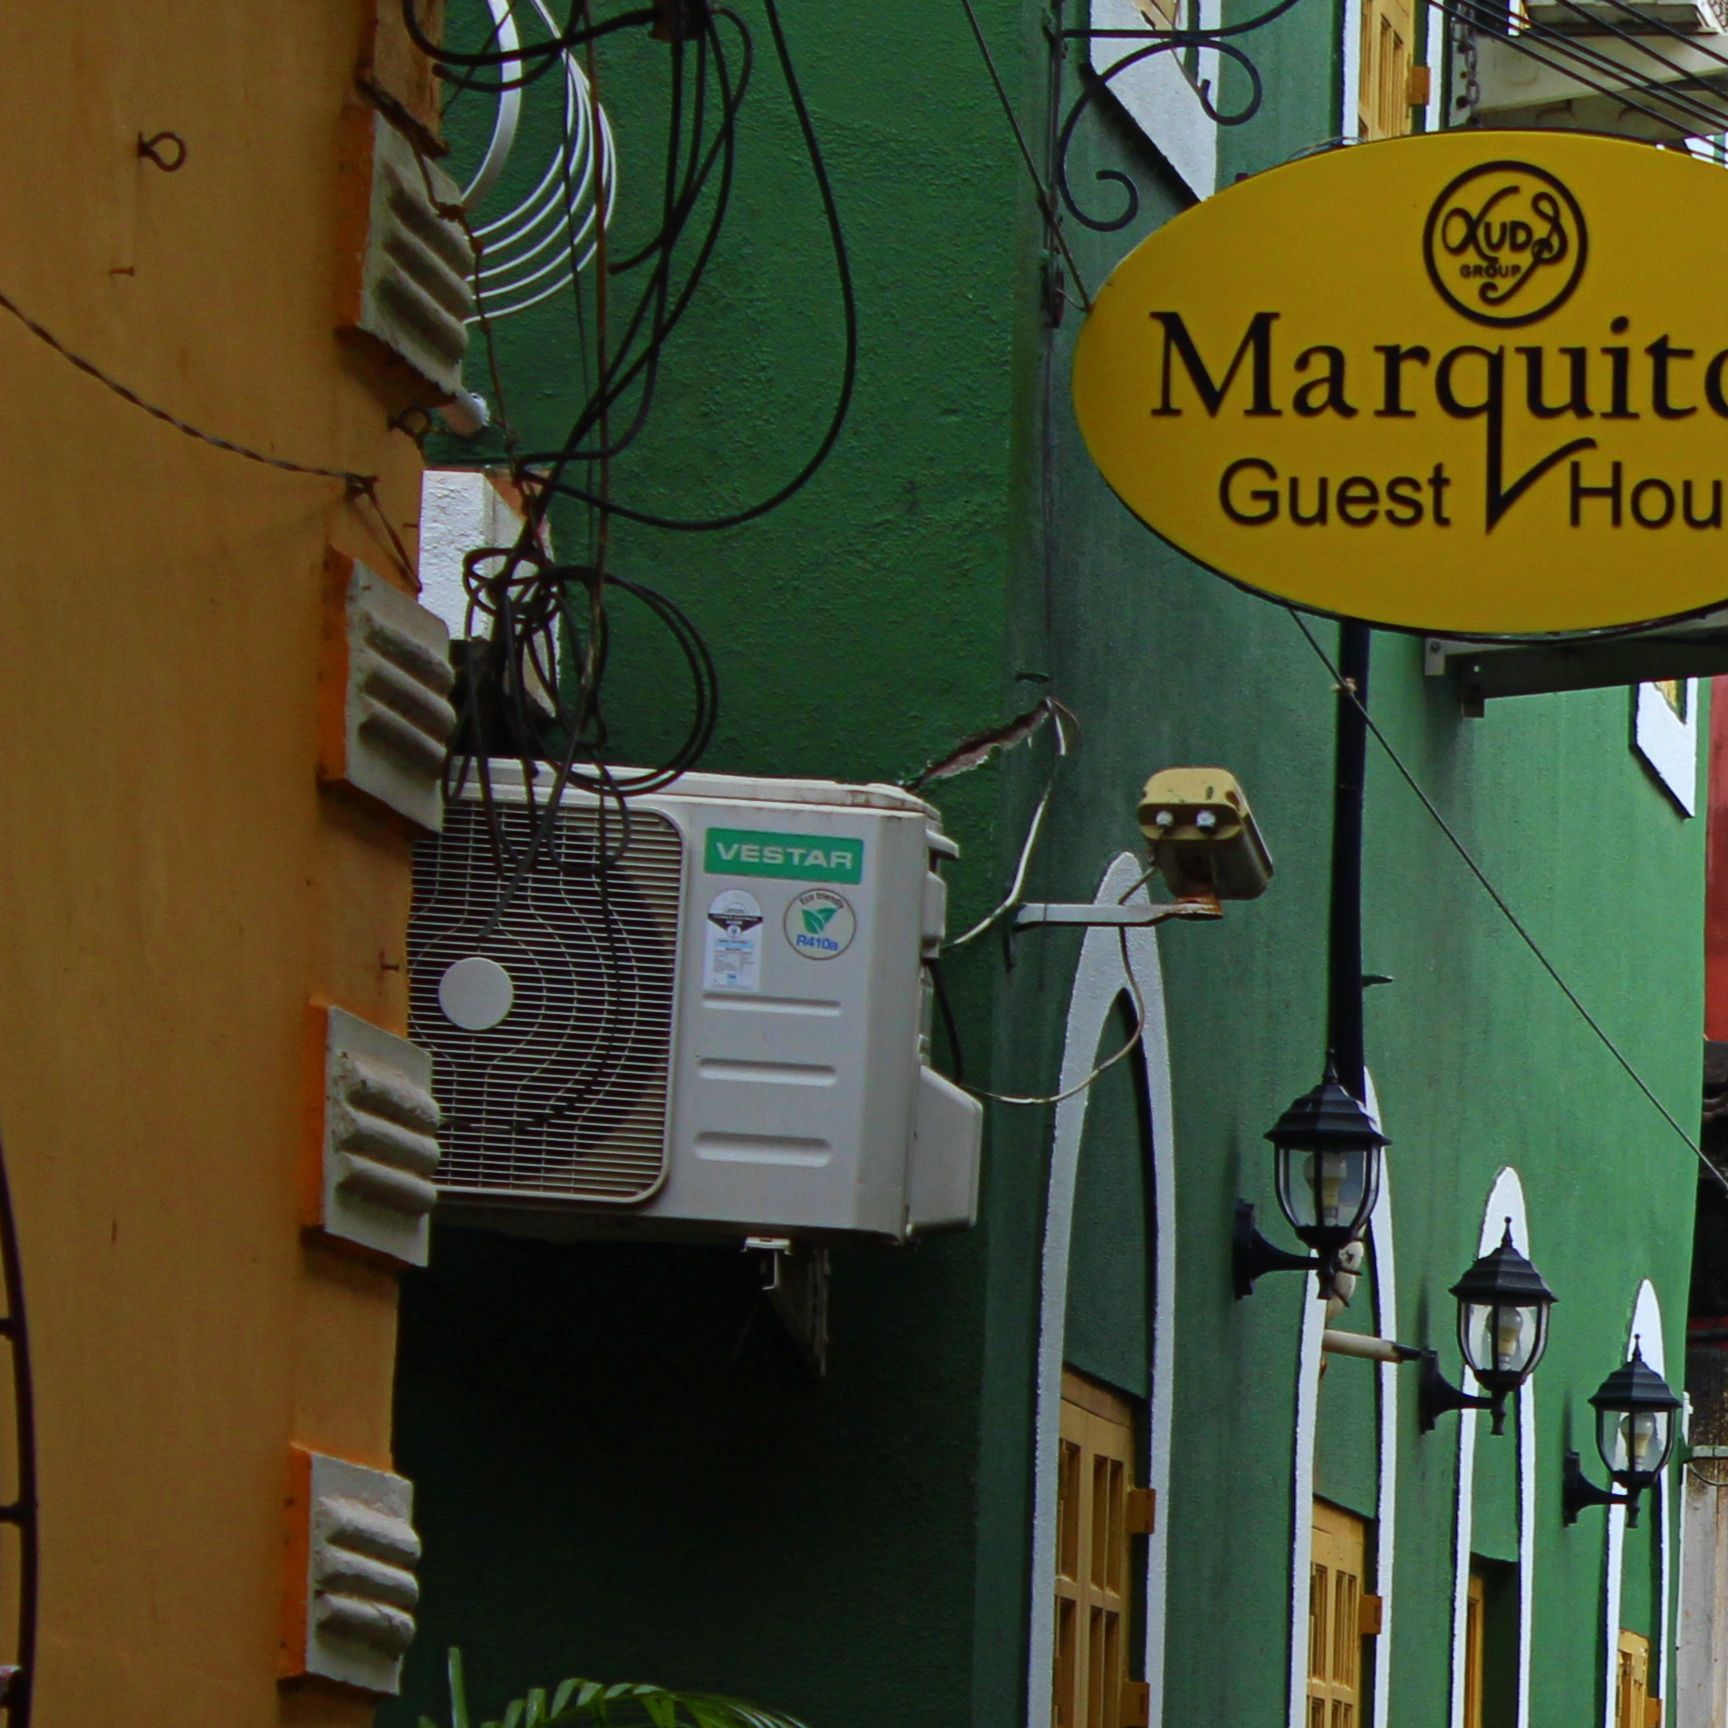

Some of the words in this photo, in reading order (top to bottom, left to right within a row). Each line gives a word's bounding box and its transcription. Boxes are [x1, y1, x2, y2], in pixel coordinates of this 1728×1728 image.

[1459, 263, 1522, 279] GROUP
[1219, 458, 1451, 528] Guest
[715, 841, 854, 870] VESTAR
